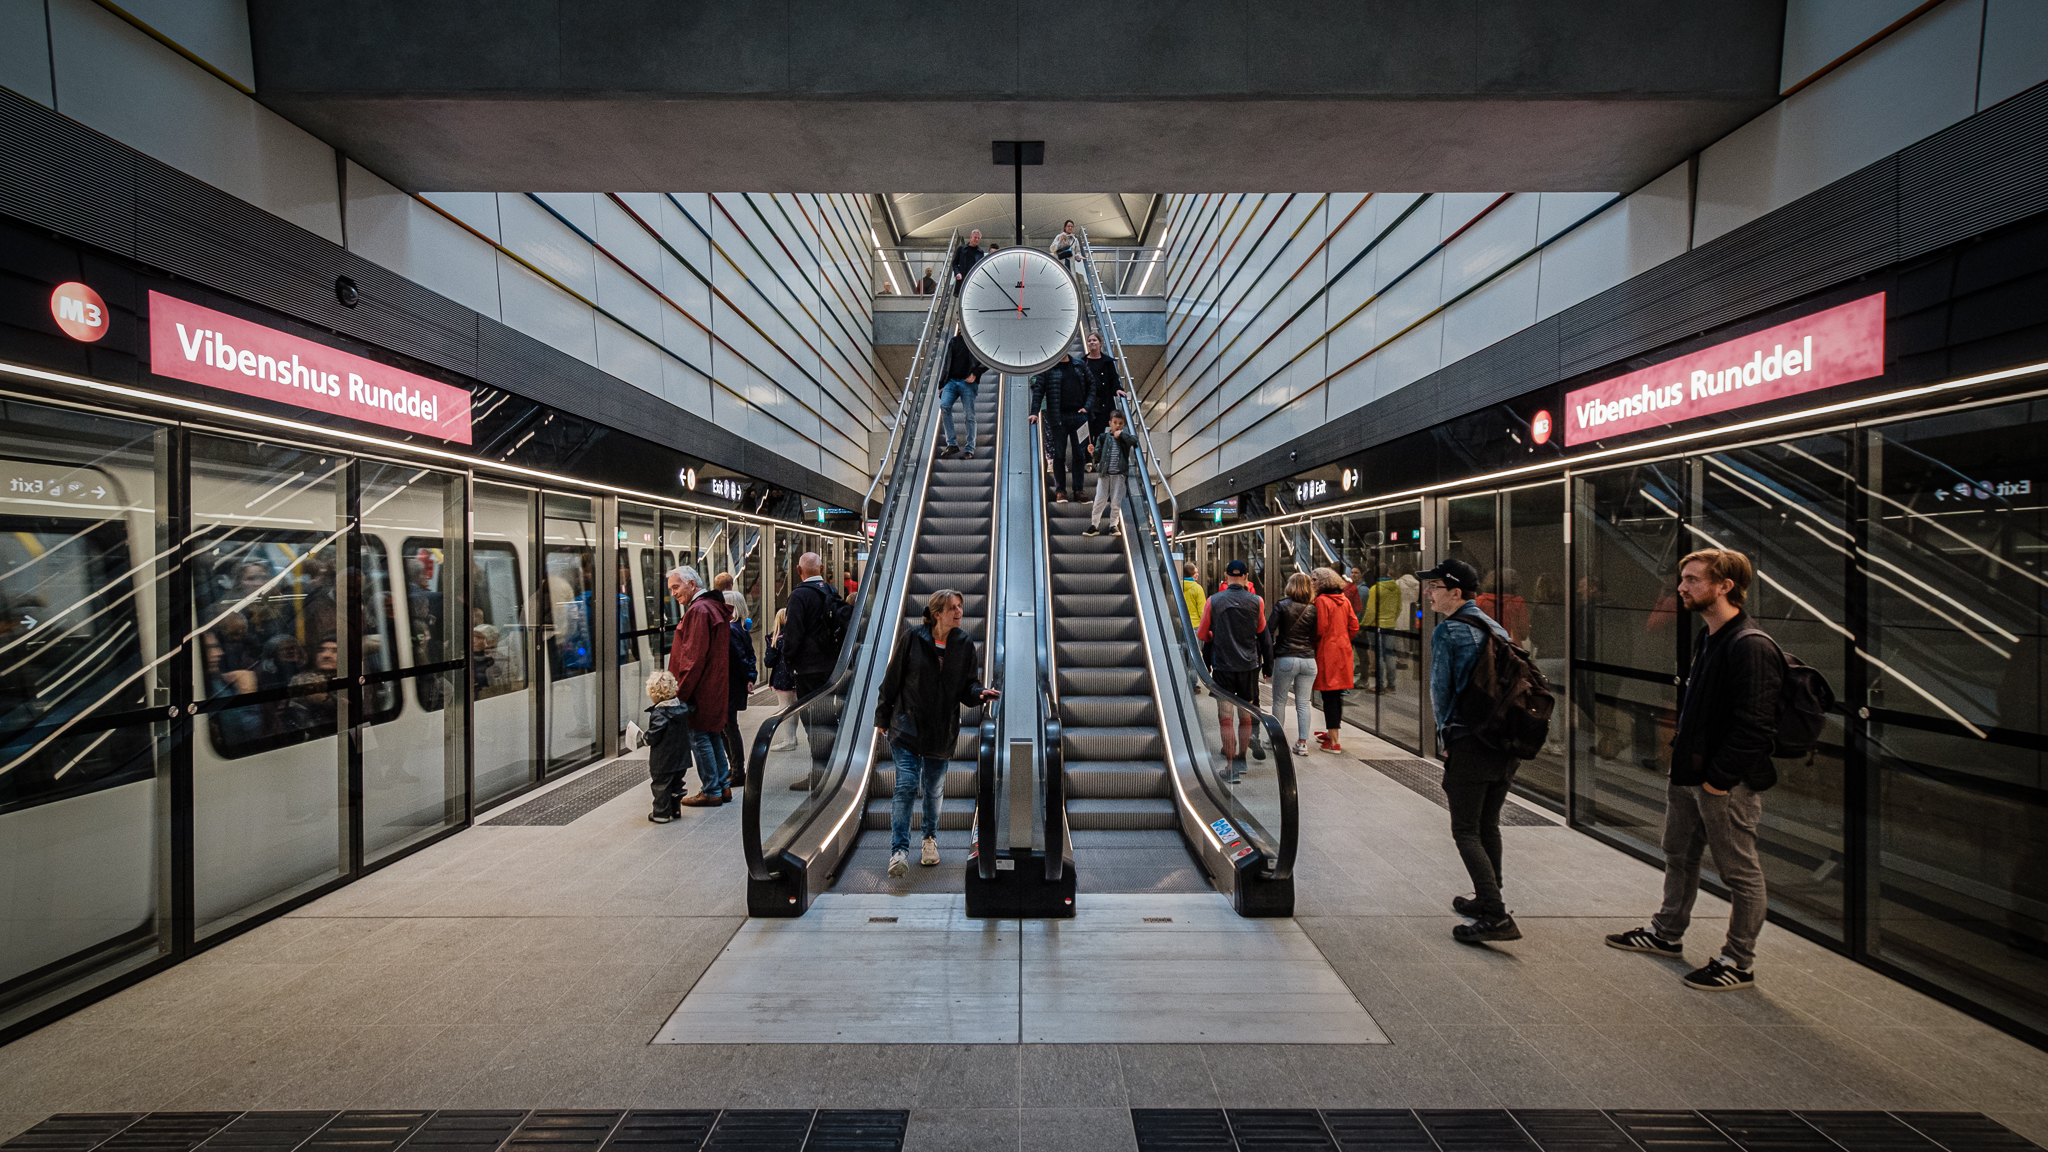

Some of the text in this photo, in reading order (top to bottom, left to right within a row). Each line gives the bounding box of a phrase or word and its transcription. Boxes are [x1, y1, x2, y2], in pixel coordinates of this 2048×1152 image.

[59, 295, 102, 327] M3
[176, 323, 438, 422] Vibenshus Runddel
[1576, 335, 1813, 429] Vibenshus Runddel
[1534, 419, 1549, 435] M3
[712, 479, 724, 495] Exit
[1315, 480, 1327, 496] Exit
